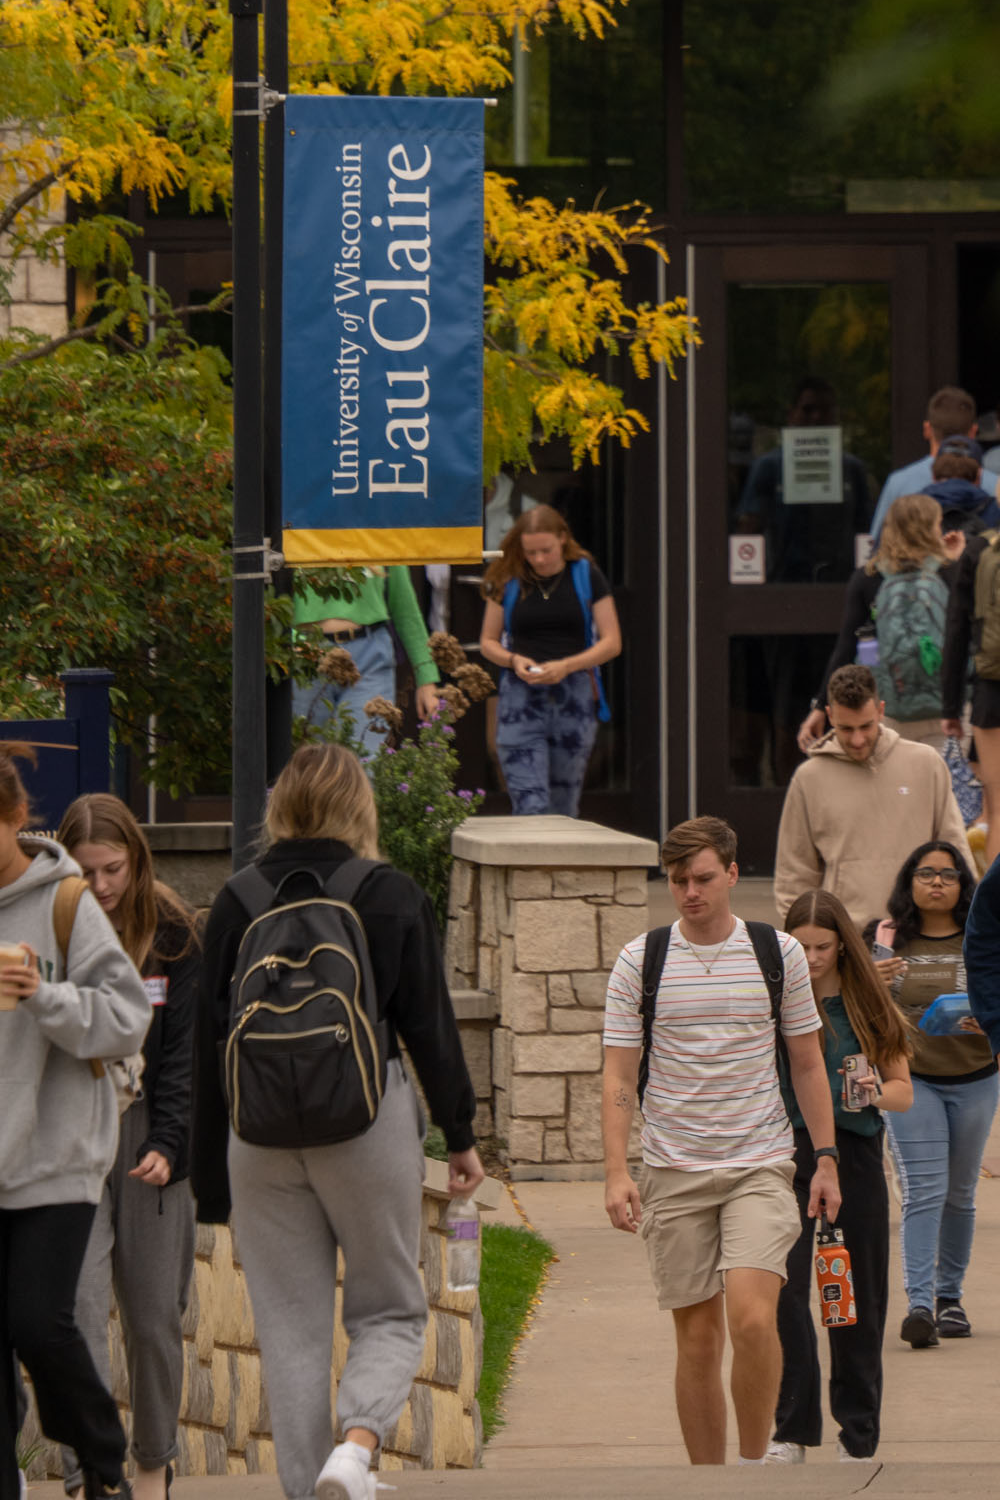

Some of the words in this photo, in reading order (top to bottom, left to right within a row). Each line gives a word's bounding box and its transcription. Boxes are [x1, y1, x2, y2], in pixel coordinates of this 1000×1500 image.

[333, 142, 362, 303] Wisconsin
[365, 143, 432, 352] Claire
[336, 309, 365, 333] of
[331, 337, 368, 497] University
[368, 365, 431, 499] Eau
